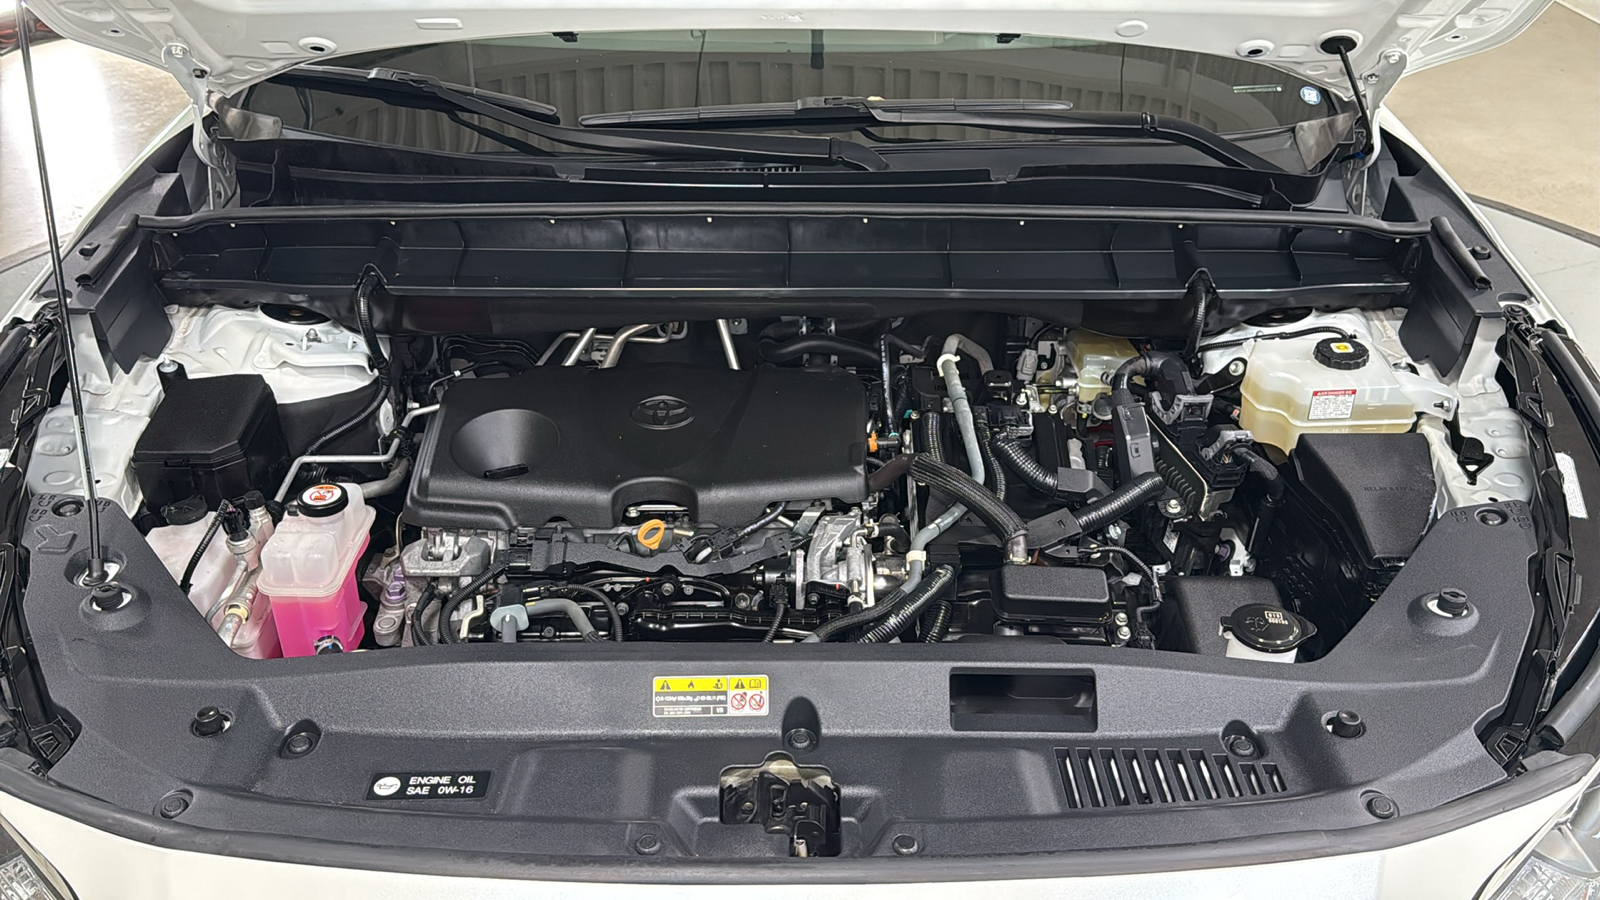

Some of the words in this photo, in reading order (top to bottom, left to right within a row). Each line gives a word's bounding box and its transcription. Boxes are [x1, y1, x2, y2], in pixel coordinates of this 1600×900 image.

[409, 775, 452, 785] ENGINE
[457, 775, 477, 784] OIL
[406, 786, 430, 795] SAE
[437, 785, 474, 794] 0W-16
